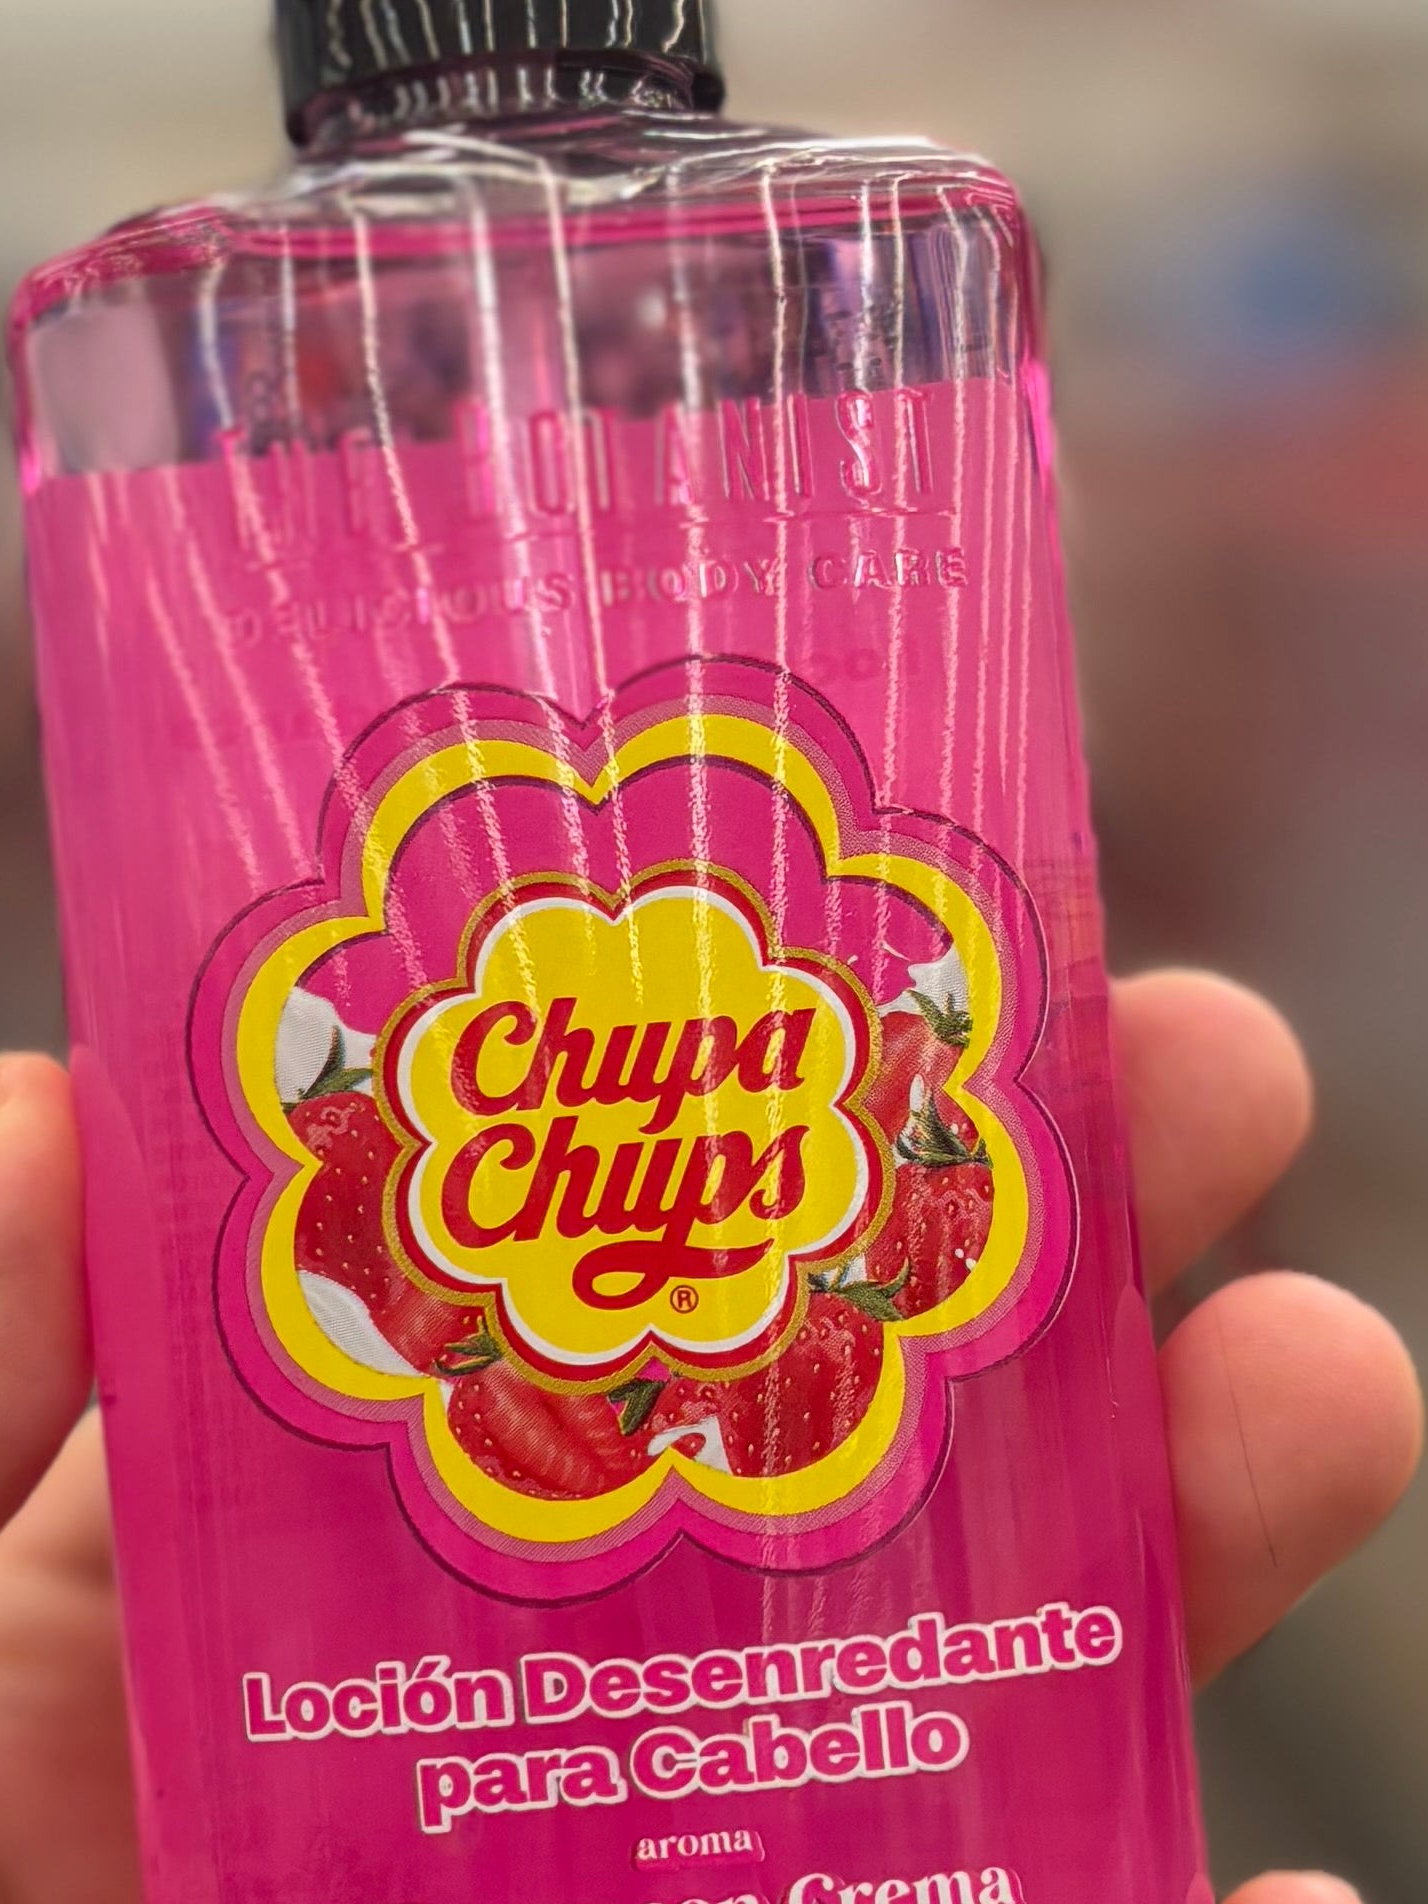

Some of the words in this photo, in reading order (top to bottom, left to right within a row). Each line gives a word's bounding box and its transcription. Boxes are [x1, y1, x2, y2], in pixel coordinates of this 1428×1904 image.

[604, 555, 780, 609] BODY
[810, 546, 971, 595] CARE
[449, 996, 817, 1135] Chupa
[441, 1115, 811, 1310] Chups
[243, 1654, 515, 1742] Loción
[519, 1601, 1123, 1724] Desenredante
[417, 1745, 627, 1834] para
[630, 1700, 970, 1799] Cabello
[635, 1828, 754, 1861] aroma
